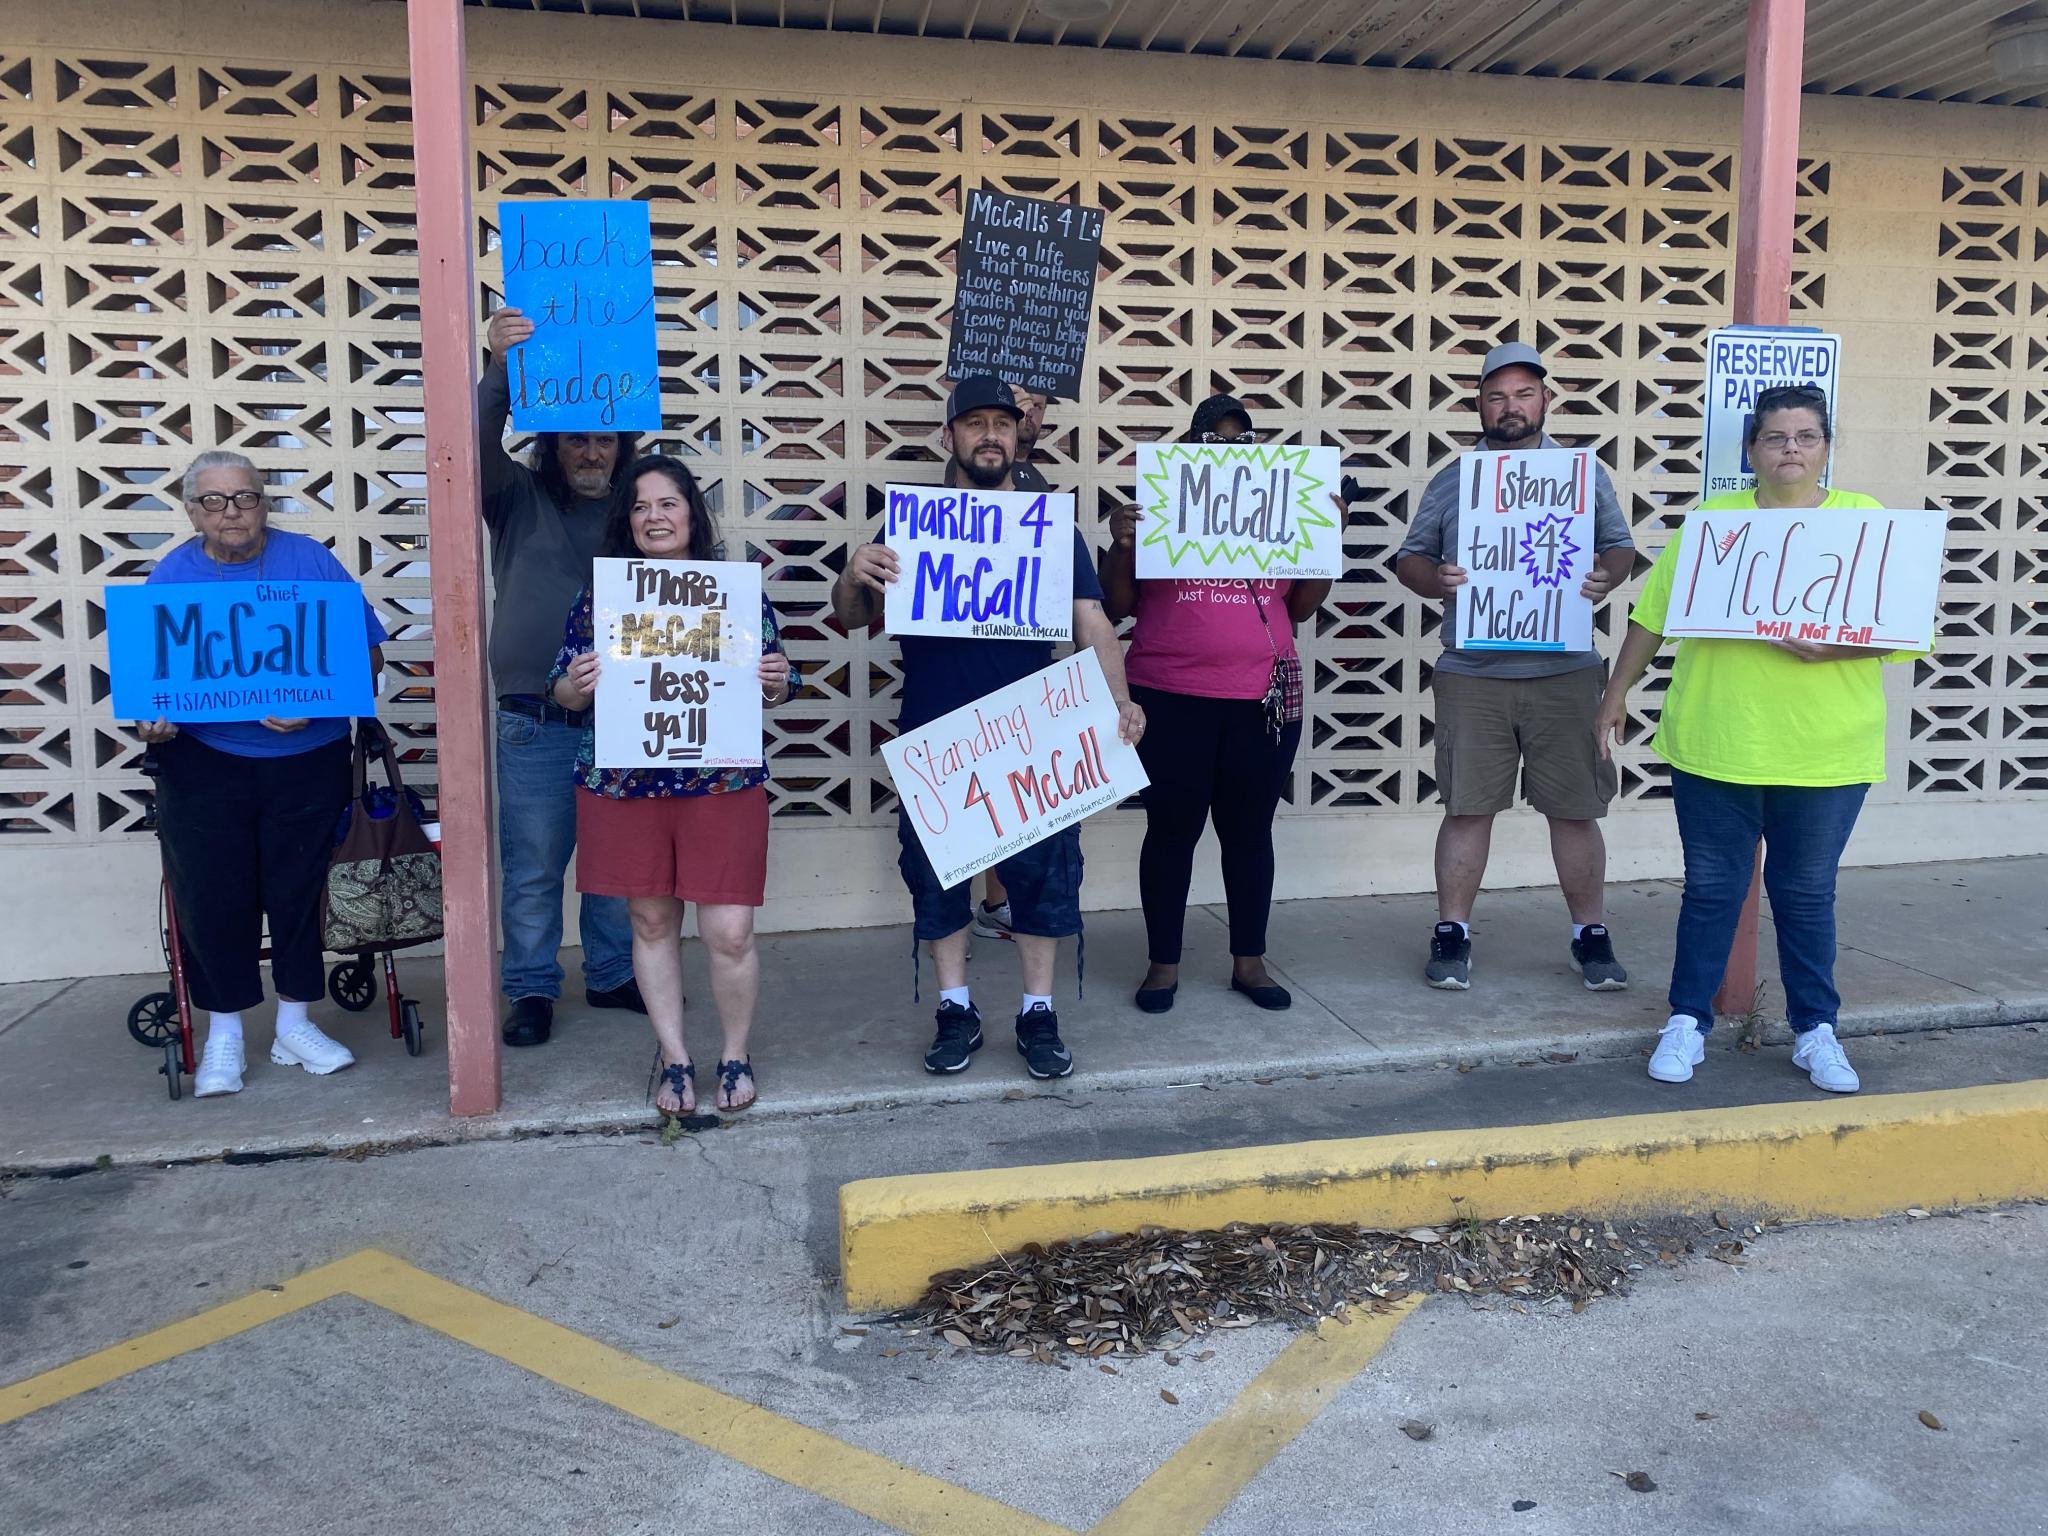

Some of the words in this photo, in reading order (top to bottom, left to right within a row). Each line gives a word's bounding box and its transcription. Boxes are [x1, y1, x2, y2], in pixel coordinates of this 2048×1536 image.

[1057, 208, 1073, 238] 4
[1078, 211, 1101, 242] L's
[975, 231, 1010, 257] Live
[1016, 245, 1028, 261] a
[1034, 240, 1065, 266] life
[980, 256, 1019, 277] that
[536, 280, 652, 327] the
[965, 269, 1002, 292] Love
[1009, 279, 1088, 310] something
[963, 309, 1006, 330] Leave
[1008, 315, 1051, 338] places
[1023, 298, 1059, 319] than
[1063, 307, 1090, 328] you
[963, 328, 998, 347] than
[1001, 335, 1026, 351] you
[1027, 335, 1068, 360] found
[1070, 343, 1084, 362] it
[1716, 343, 1830, 378] RESERVED
[998, 369, 1025, 385] you
[1471, 458, 1483, 510] I
[1711, 477, 1738, 490] STATE
[1019, 494, 1053, 549] 4
[1178, 463, 1296, 546] McCall
[1467, 525, 1516, 572] tall
[1534, 524, 1560, 574] 4
[256, 583, 300, 602] Chief
[911, 551, 1042, 628] McCall
[1684, 520, 1895, 627] McCall
[1176, 588, 1205, 604] just
[1210, 589, 1248, 605] loves
[1467, 586, 1564, 643] McCall
[152, 600, 336, 681] McCall
[1756, 620, 1793, 640] Will
[1797, 623, 1831, 641] Not
[1836, 625, 1873, 645] Fall
[903, 707, 1033, 836] Standing
[1040, 661, 1091, 719] tall
[963, 770, 1005, 839] 4
[1007, 725, 1111, 825] McCall
